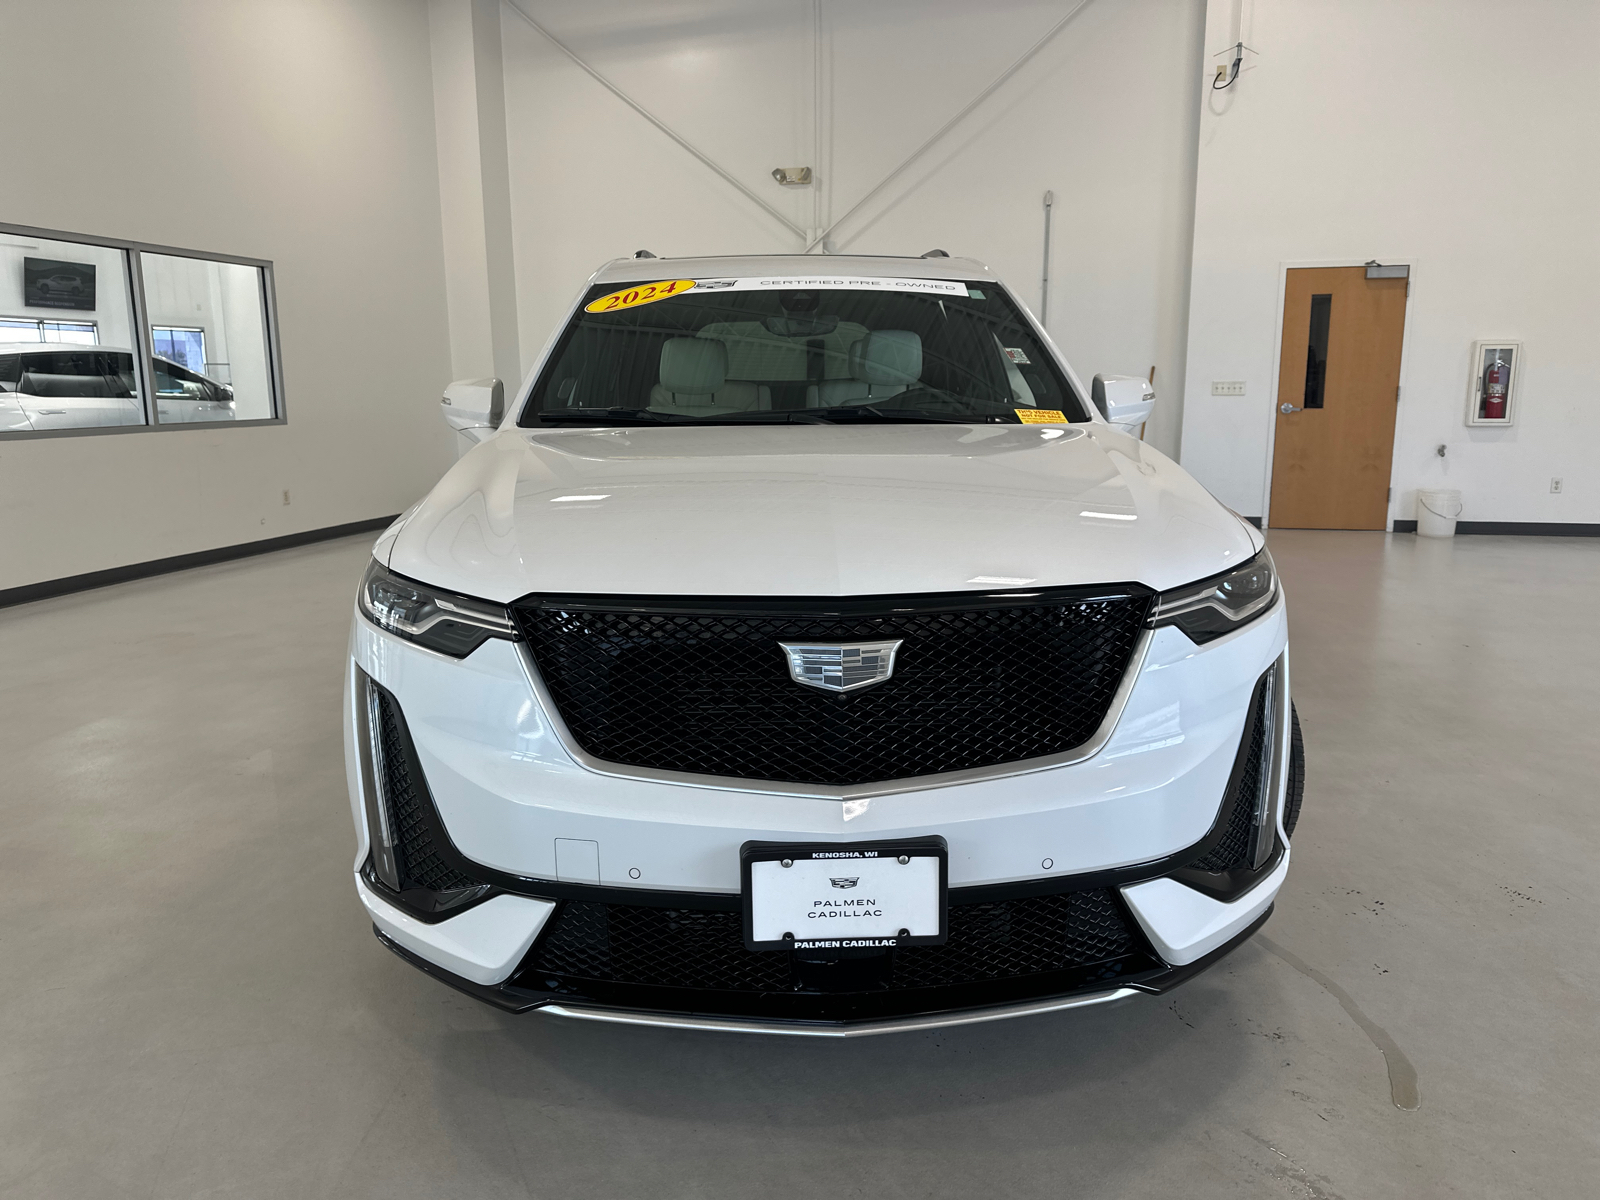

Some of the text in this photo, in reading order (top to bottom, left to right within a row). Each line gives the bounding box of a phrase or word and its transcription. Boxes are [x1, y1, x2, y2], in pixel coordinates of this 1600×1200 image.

[895, 281, 956, 291] OWNED
[604, 281, 677, 311] 2024
[813, 899, 876, 908] PALMEN
[807, 909, 883, 919] CADILLAC
[794, 939, 897, 949] PALMEN CADILLAC
